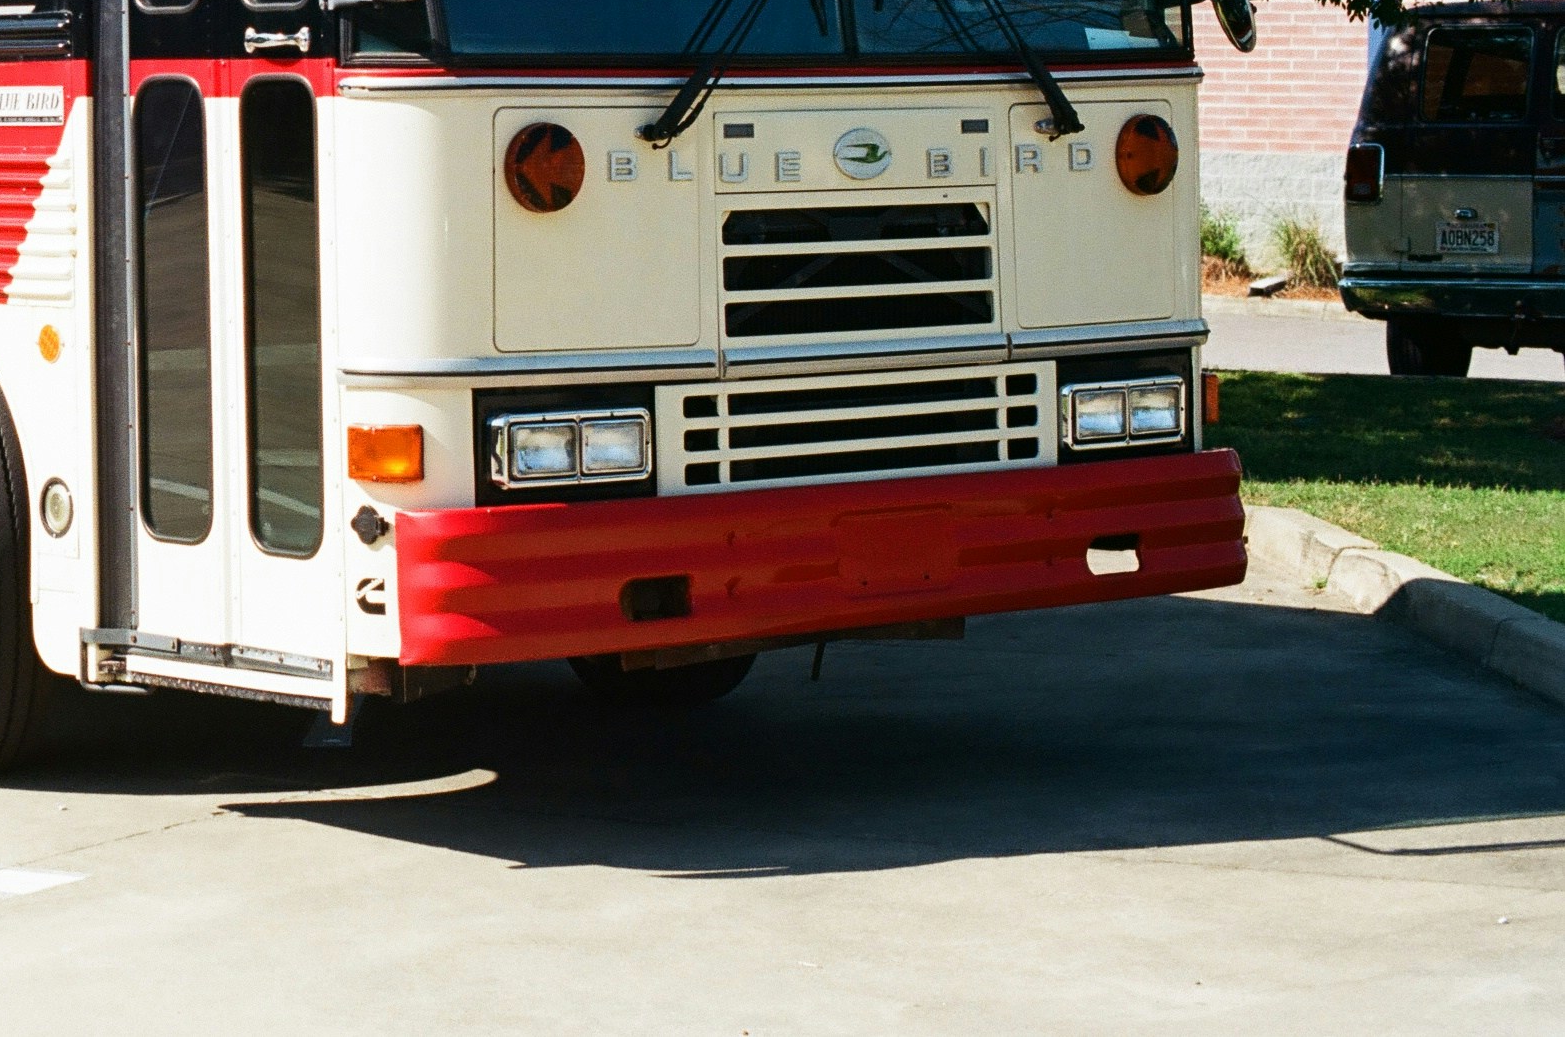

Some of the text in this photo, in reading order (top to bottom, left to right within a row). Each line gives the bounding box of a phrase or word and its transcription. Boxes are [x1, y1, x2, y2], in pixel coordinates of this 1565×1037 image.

[26, 92, 60, 110] BIRD
[607, 142, 1094, 183] BLUE BIRD
